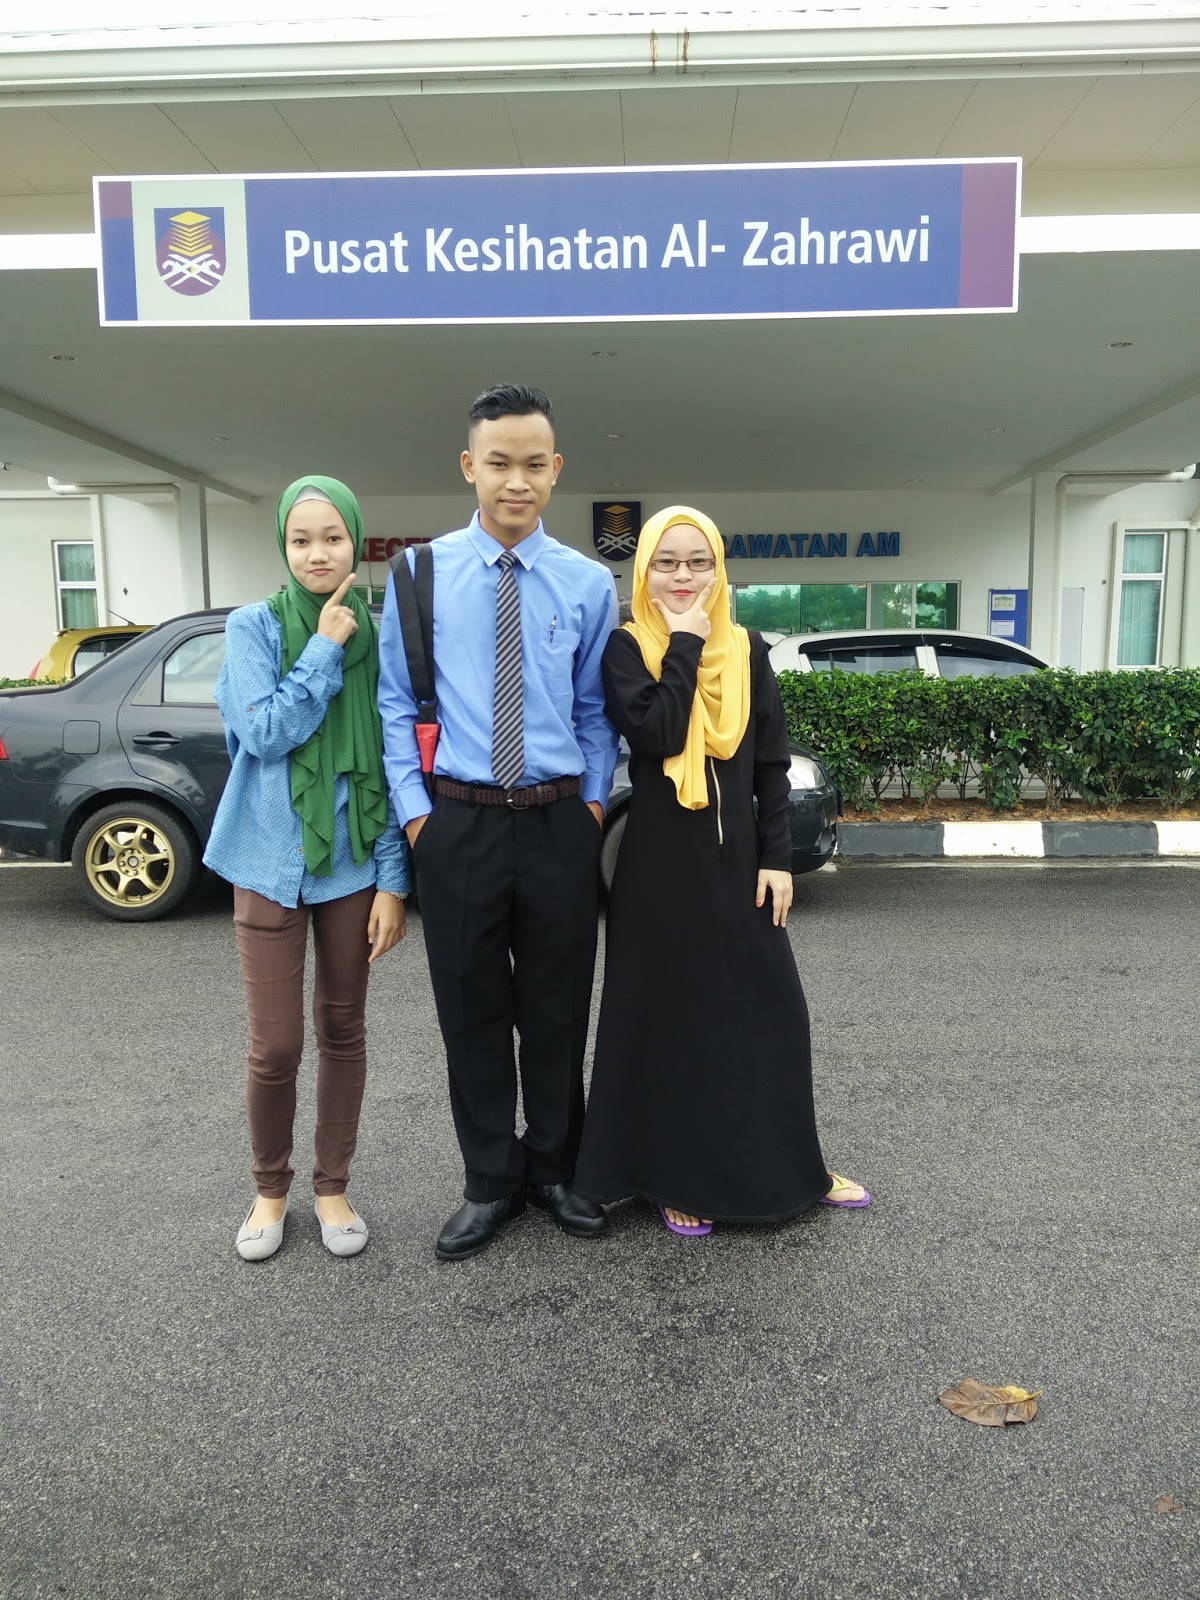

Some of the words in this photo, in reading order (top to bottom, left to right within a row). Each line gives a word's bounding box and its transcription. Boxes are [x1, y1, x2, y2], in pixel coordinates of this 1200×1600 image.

[284, 229, 409, 276] Pusat
[425, 223, 649, 273] Kesihatan
[661, 219, 727, 269] Al-
[742, 215, 931, 268] Zahrawi
[855, 531, 900, 557] AM
